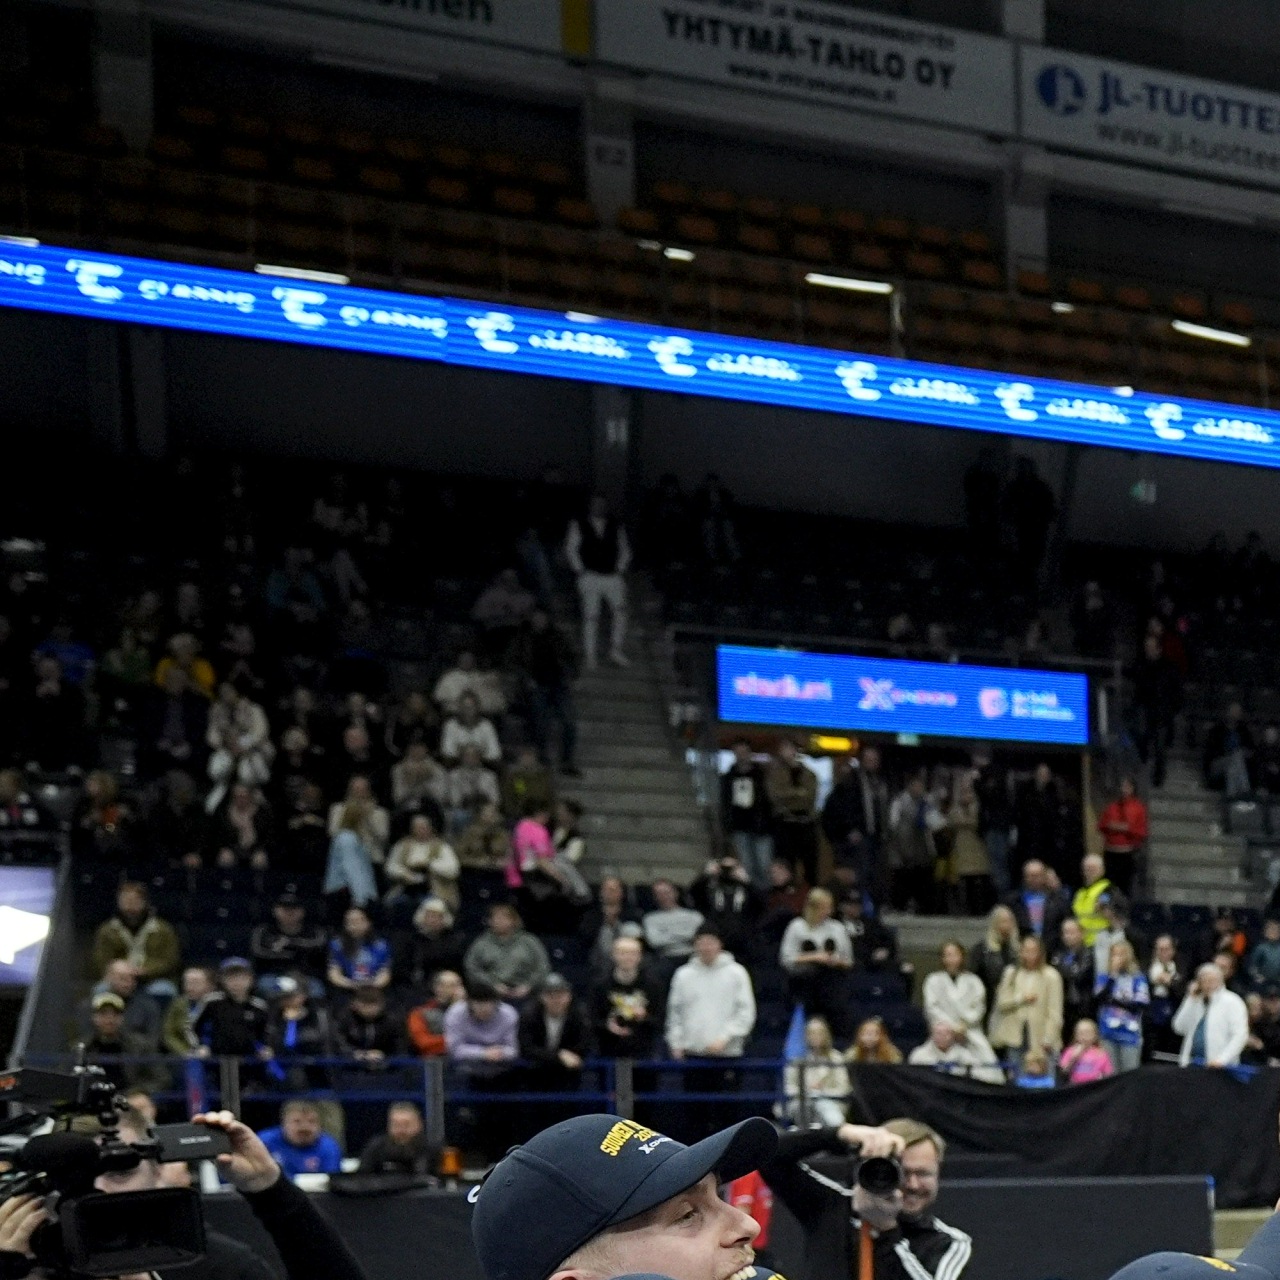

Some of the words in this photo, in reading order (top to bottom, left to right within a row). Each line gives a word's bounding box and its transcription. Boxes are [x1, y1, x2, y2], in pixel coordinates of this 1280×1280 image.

[663, 8, 905, 80] YHTYMÄ-TAHLO
[915, 57, 955, 89] OY
[600, 1121, 637, 1157] SUOMEN
